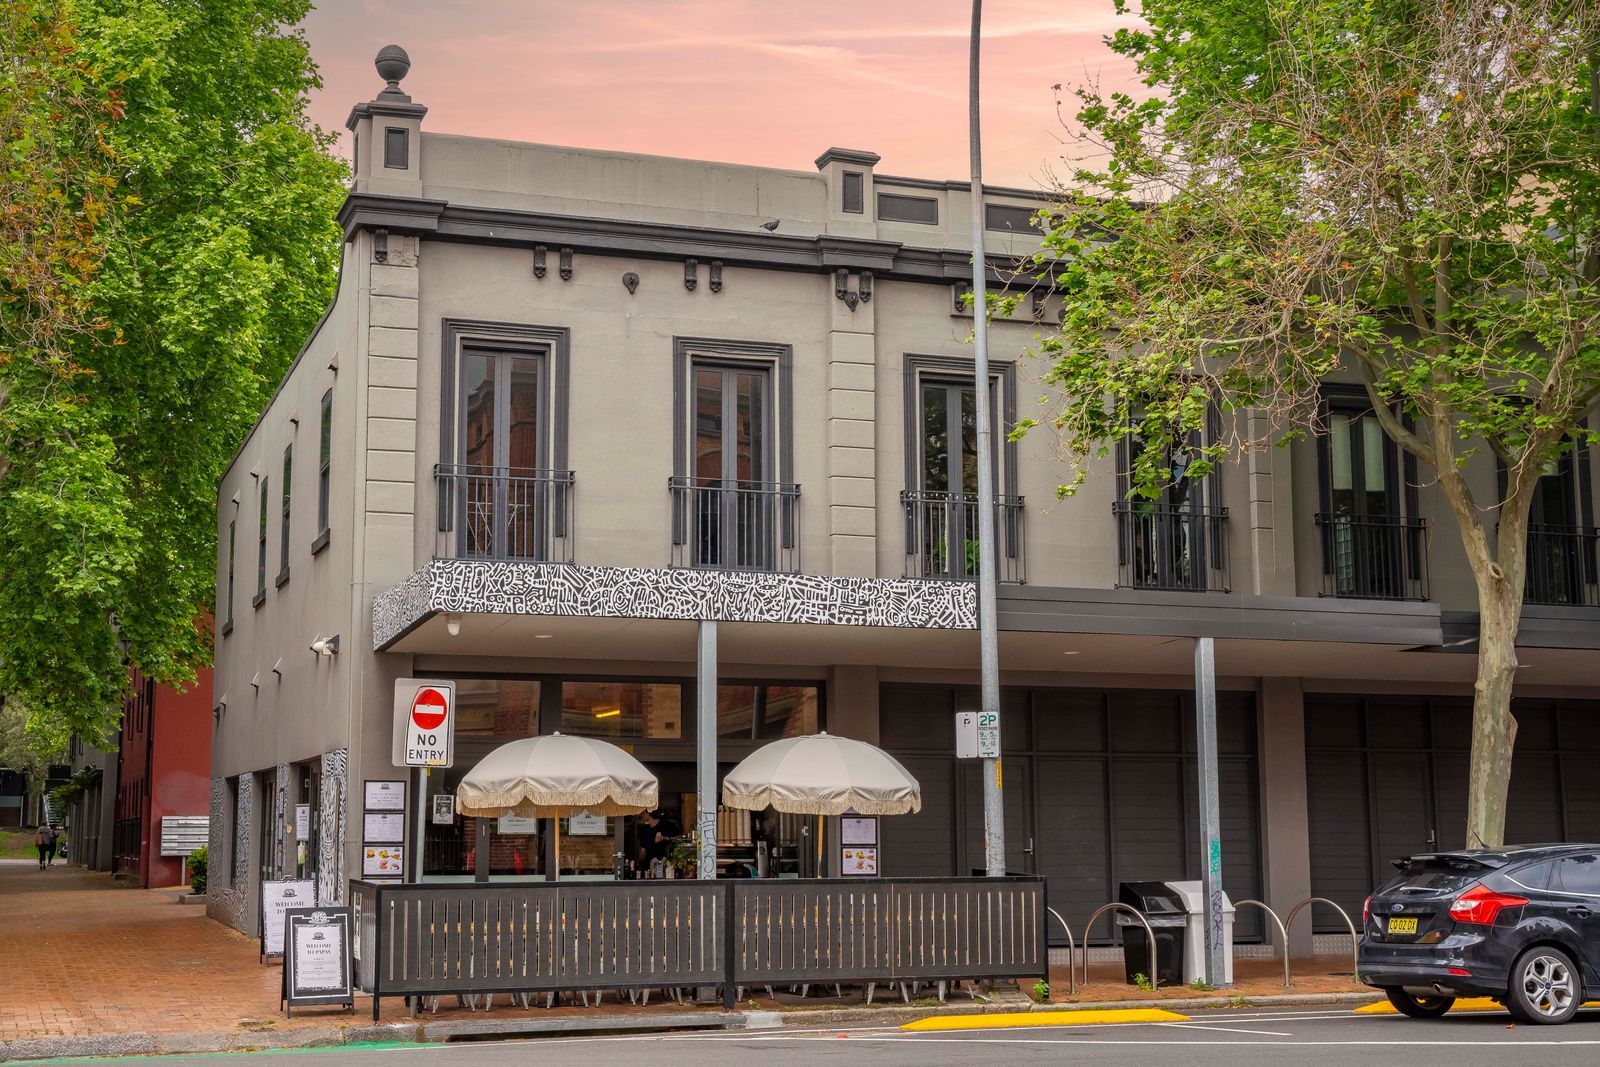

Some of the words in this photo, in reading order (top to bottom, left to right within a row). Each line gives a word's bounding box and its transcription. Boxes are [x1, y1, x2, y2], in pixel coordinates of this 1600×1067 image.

[980, 715, 996, 726] 2P
[417, 733, 437, 746] NO
[409, 749, 444, 760] ENTRY
